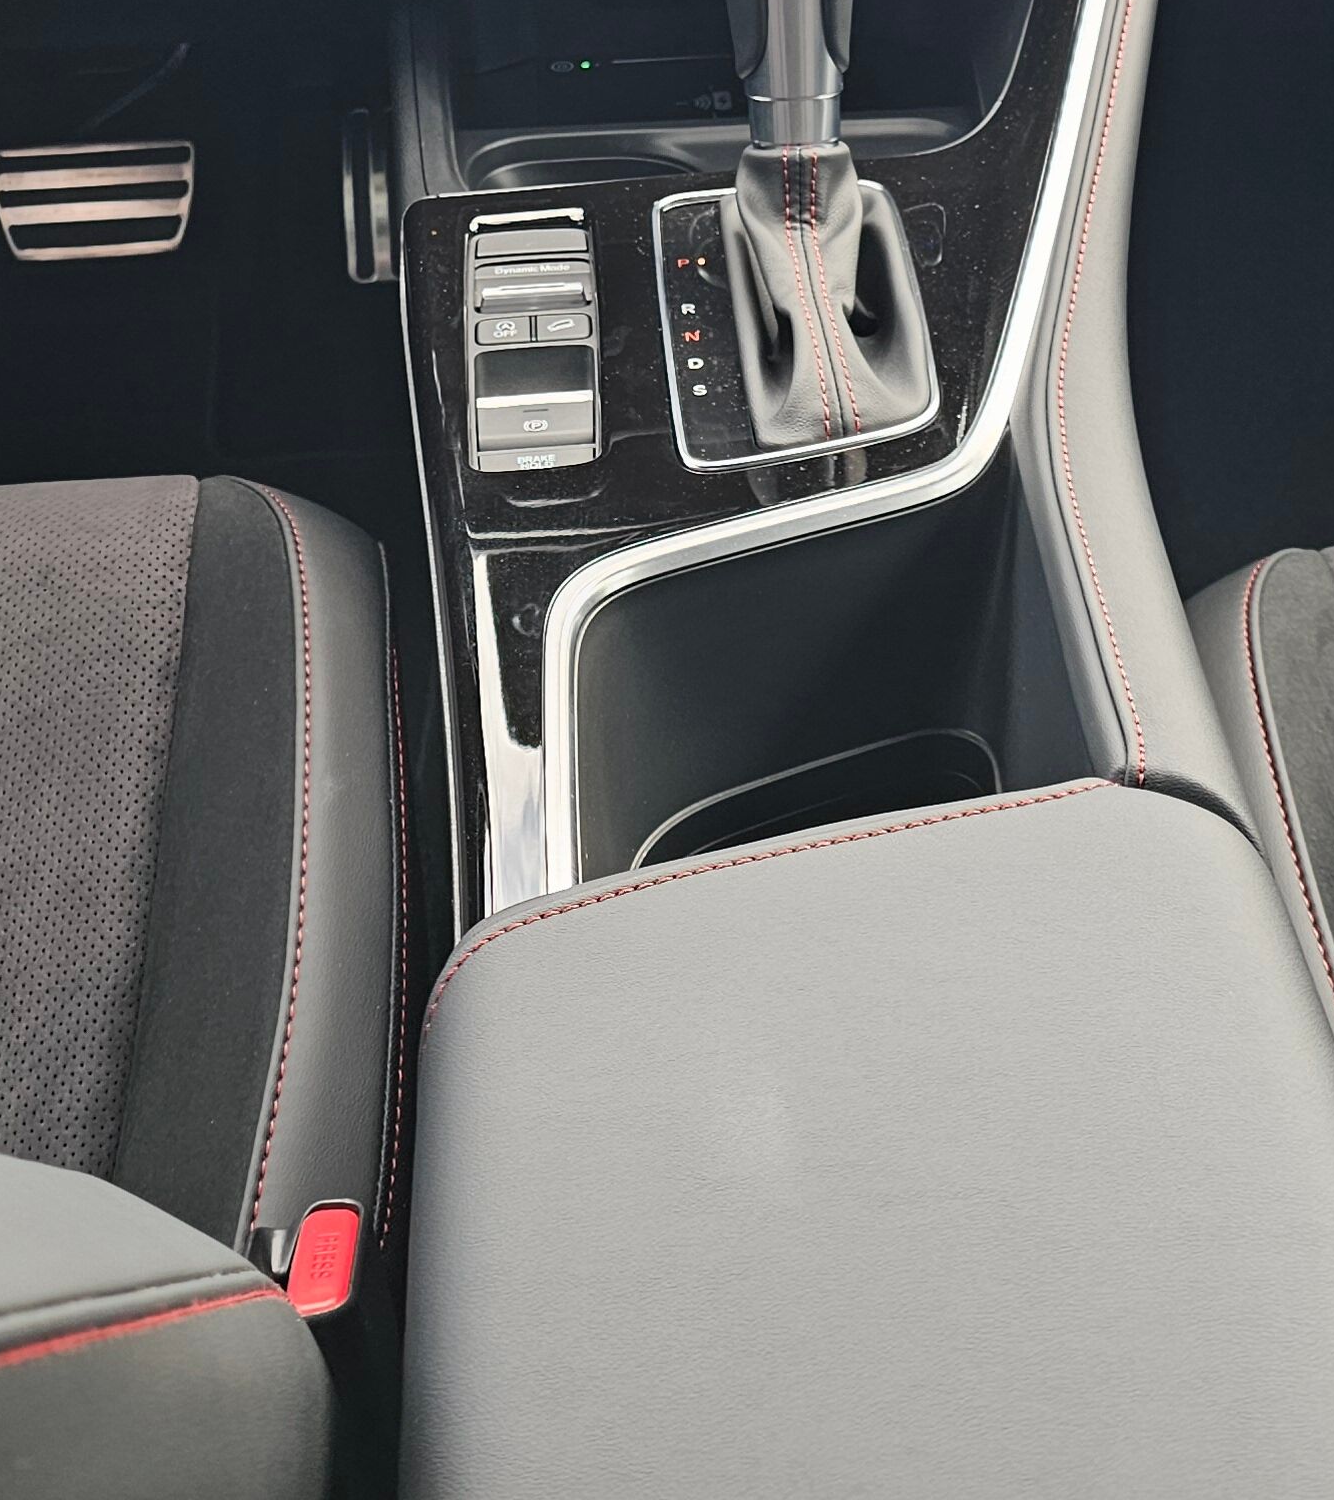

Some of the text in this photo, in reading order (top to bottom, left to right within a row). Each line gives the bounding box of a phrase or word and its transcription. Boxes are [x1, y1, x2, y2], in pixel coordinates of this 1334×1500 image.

[677, 258, 690, 268] P
[494, 264, 570, 275] Dynamic Mode
[680, 303, 696, 315] R
[493, 329, 517, 338] OFF
[684, 330, 701, 342] N
[687, 357, 705, 370] D
[692, 384, 708, 396] S
[517, 455, 556, 464] BRAKE
[310, 1231, 341, 1280] PRESS
